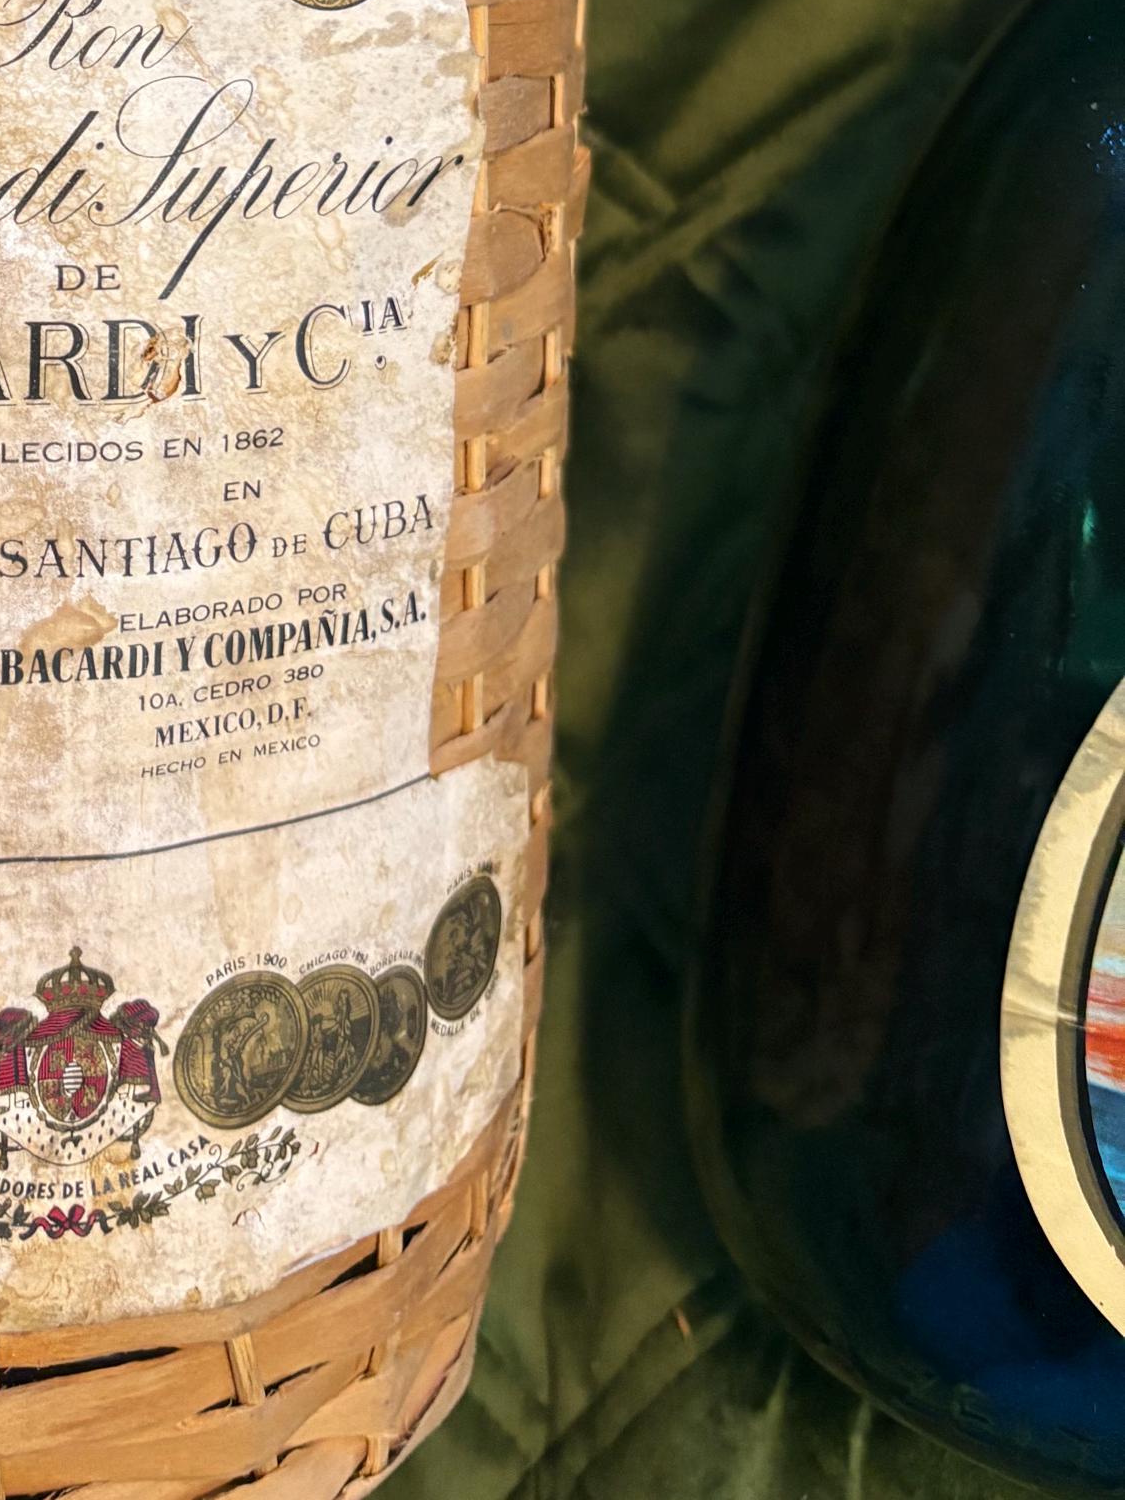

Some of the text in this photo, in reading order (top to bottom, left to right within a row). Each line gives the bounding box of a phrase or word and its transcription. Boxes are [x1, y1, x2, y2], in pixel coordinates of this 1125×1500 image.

[87, 75, 465, 300] Superior
[55, 264, 121, 292] DE
[163, 437, 203, 459] EN
[223, 427, 285, 452] 1862
[223, 479, 262, 501] EN
[272, 533, 308, 558] DE
[322, 493, 434, 550] CUBA
[119, 582, 347, 633] ELABORADO POR
[0, 640, 164, 686] BACARDI
[175, 637, 196, 673] Y
[138, 663, 325, 712] 10A. CEDRO 380
[140, 732, 322, 779] HECHO EN MEXICO
[205, 952, 287, 987] PARIS 1900
[298, 950, 348, 975] CHICAGO
[62, 1180, 84, 1199] DE
[90, 1180, 115, 1198] LA
[118, 1160, 165, 1191] REAL
[167, 1133, 212, 1169] CASA
